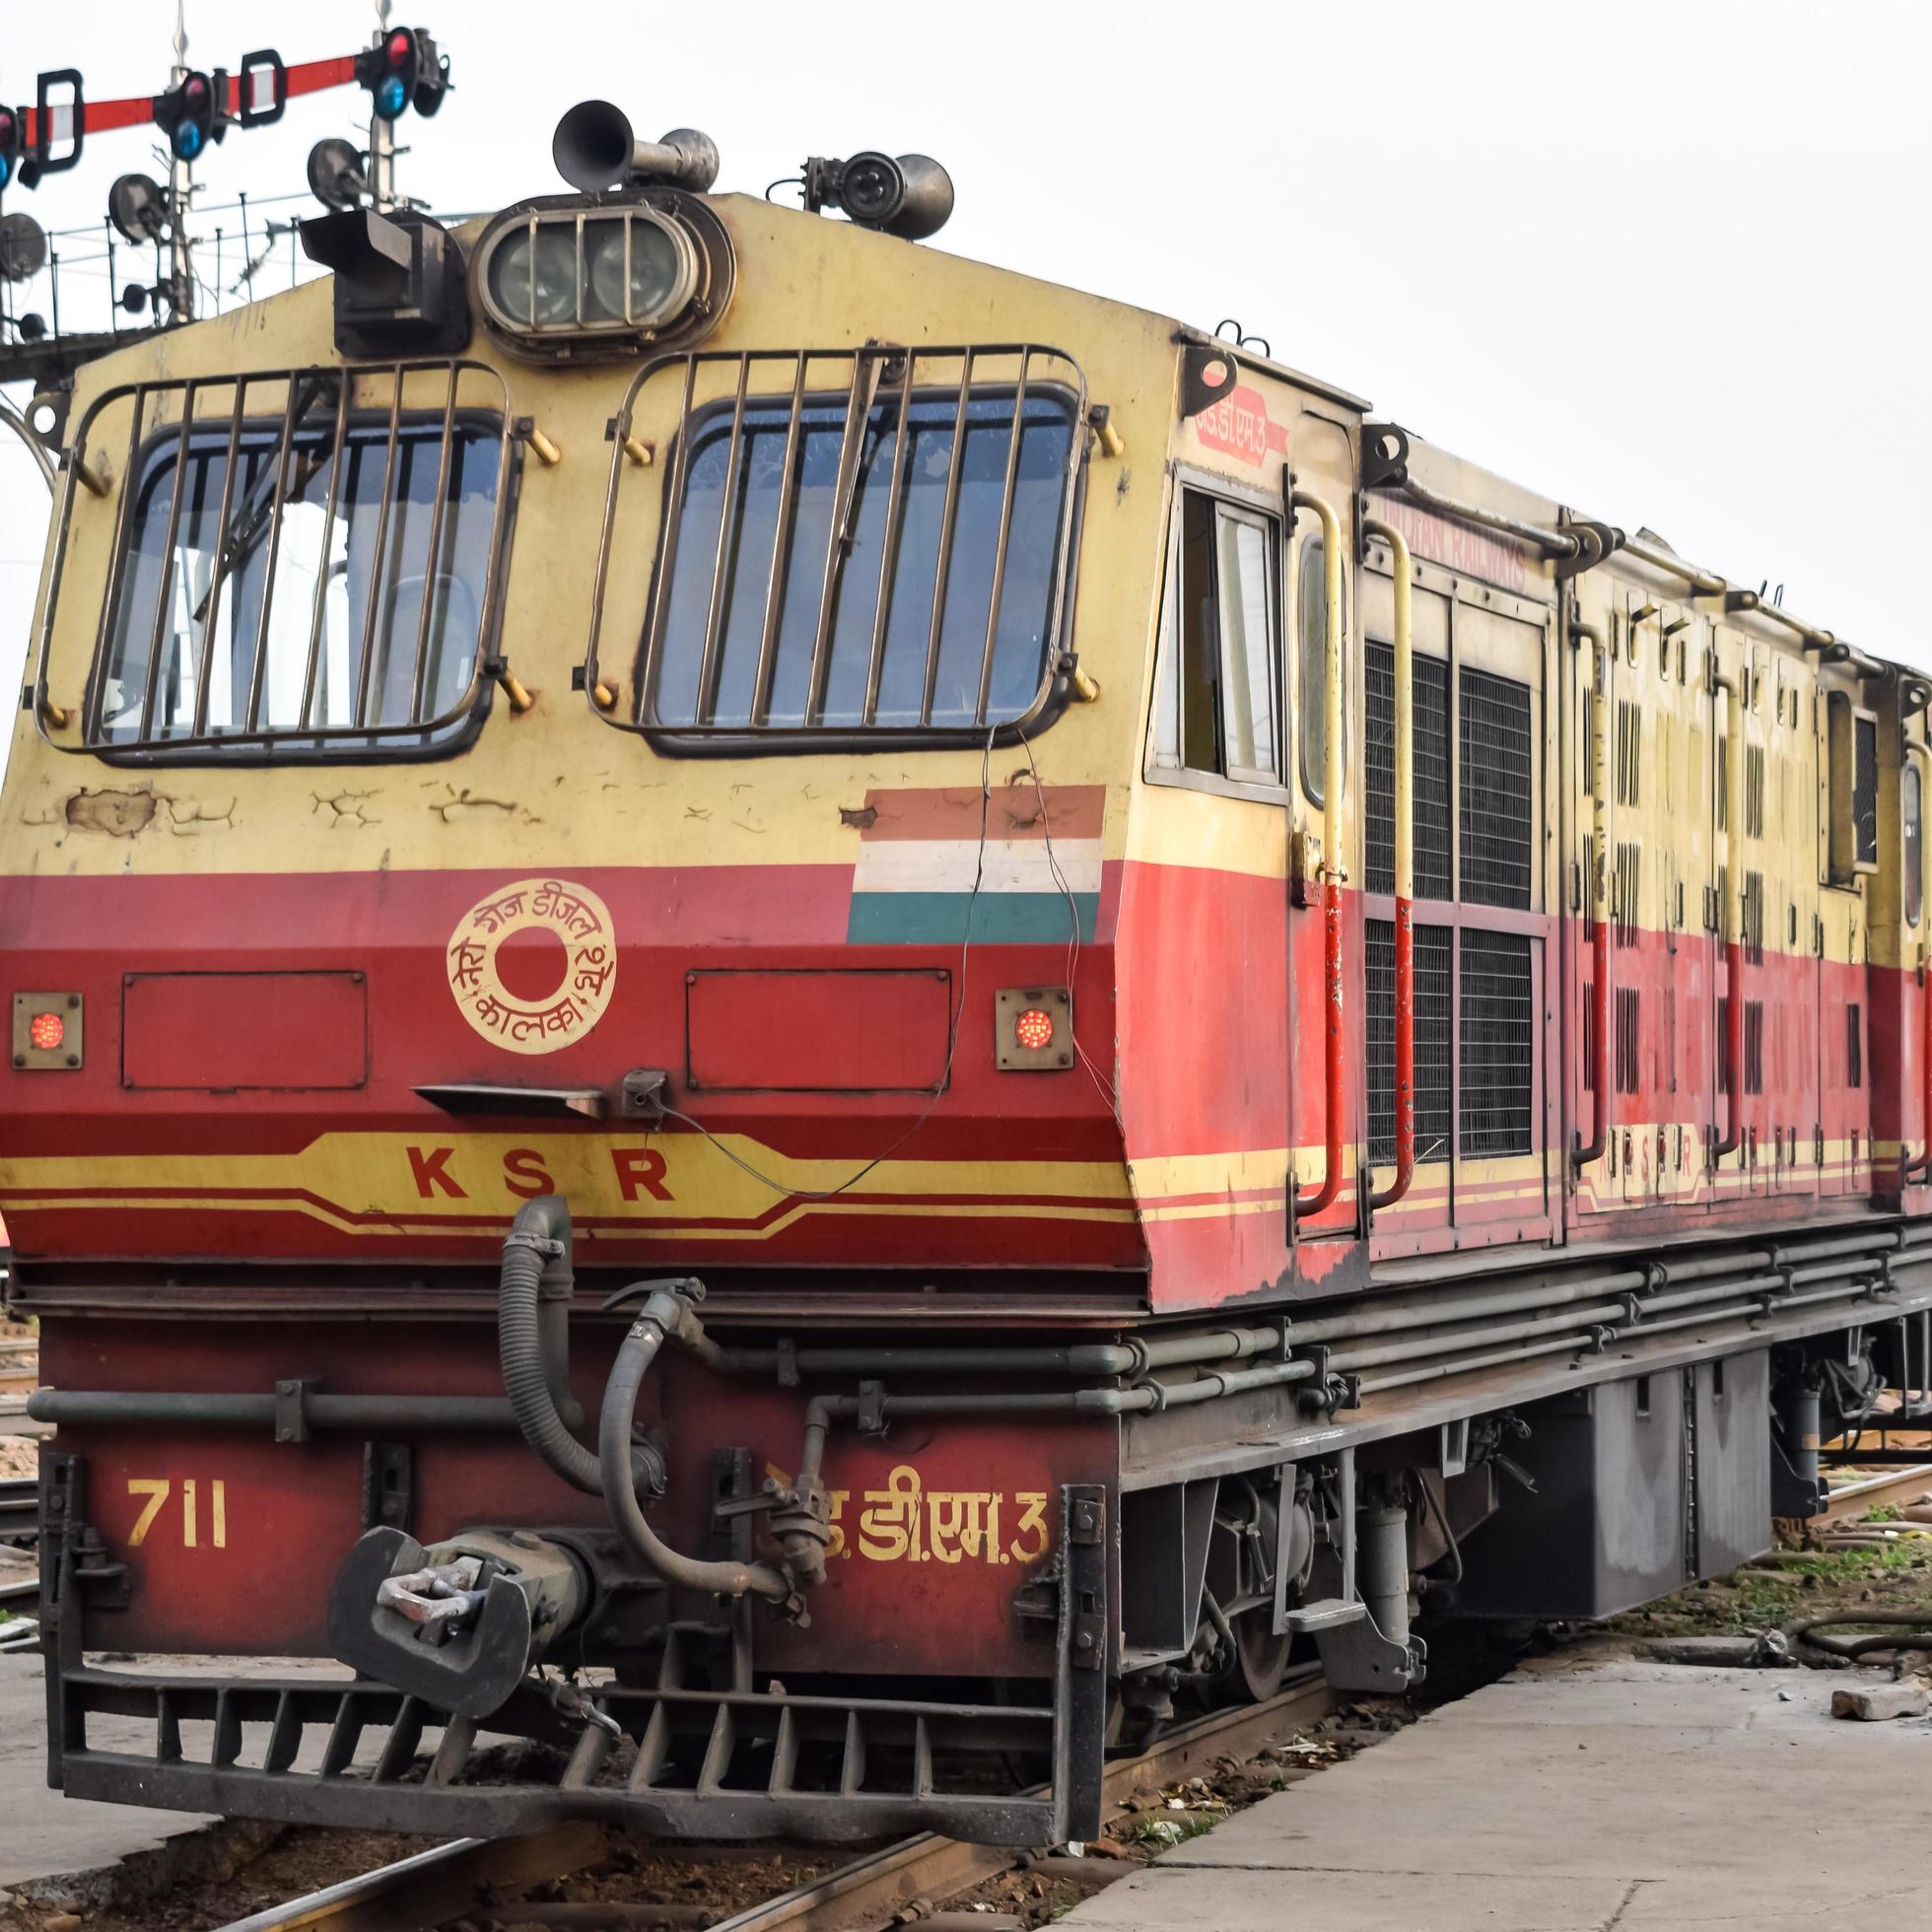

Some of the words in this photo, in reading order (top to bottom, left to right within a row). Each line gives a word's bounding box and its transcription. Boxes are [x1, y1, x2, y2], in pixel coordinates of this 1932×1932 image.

[531, 881, 603, 939] डीजल
[475, 994, 585, 1042] कालका
[127, 1479, 227, 1549] 711
